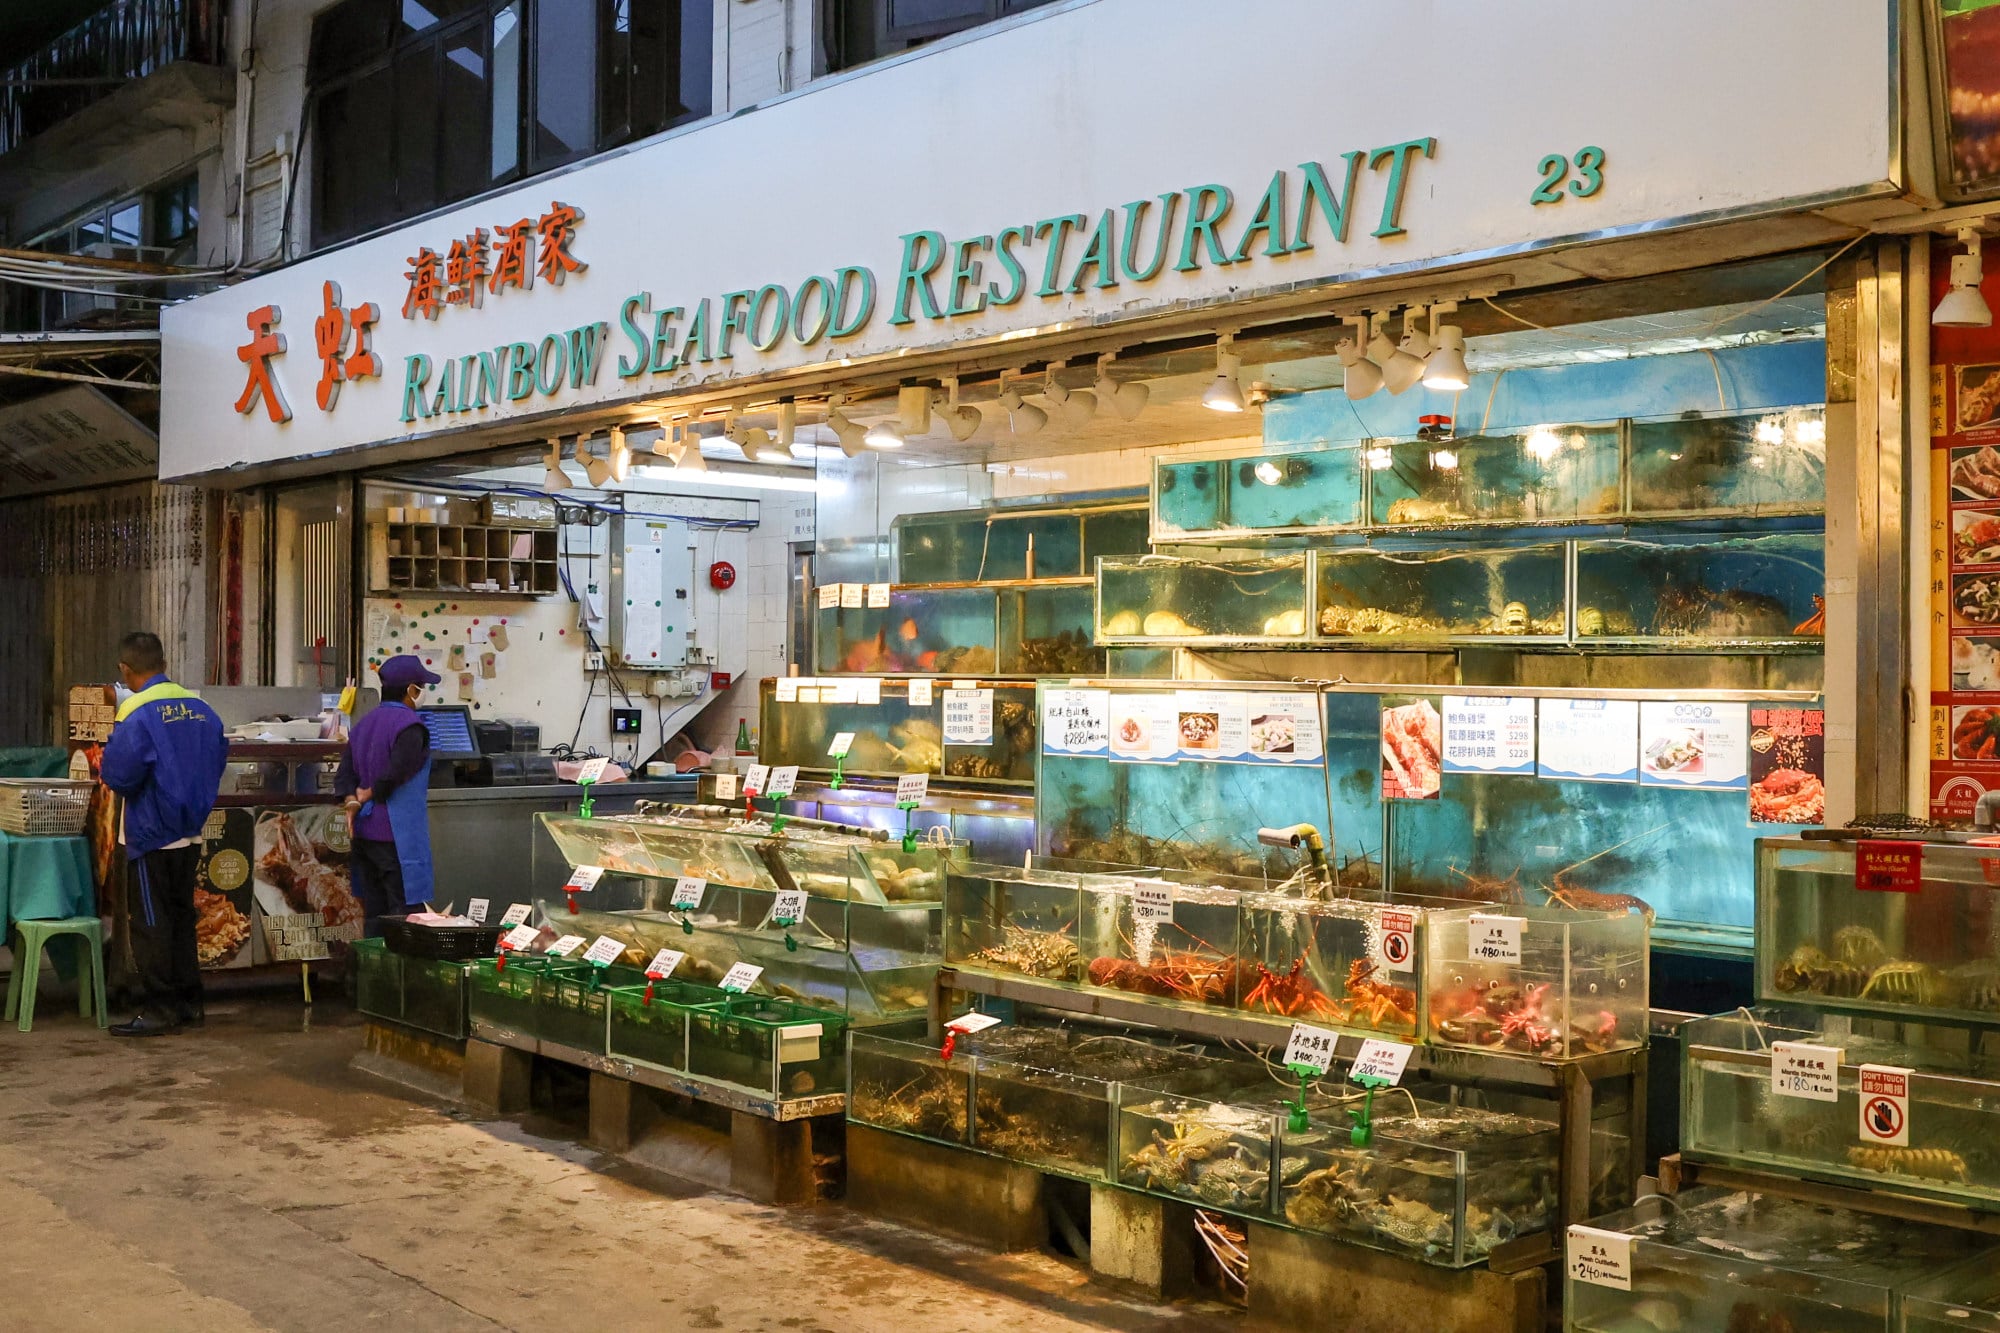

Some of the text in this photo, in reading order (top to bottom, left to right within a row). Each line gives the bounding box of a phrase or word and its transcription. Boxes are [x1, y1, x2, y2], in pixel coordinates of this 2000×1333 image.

[1530, 146, 1605, 205] 23
[402, 201, 589, 321] 海鮮酒家
[399, 137, 1436, 422] RAINBOW SEAFOOD RESTAURANT
[234, 280, 382, 423] 天虹
[1931, 519, 1944, 625] 必食推介
[1509, 715, 1529, 724] $298
[1509, 731, 1529, 740] $298
[1932, 708, 1945, 757] 創意菜
[1509, 749, 1529, 758] $228
[1382, 912, 1412, 922] DON'T TOUCH
[1781, 1068, 1832, 1082] Mantis Shrimp (M)
[1863, 1071, 1905, 1084] DON'T TOUCH
[1863, 1081, 1904, 1095] 請勿觸摸
[1579, 1255, 1620, 1268] Fresh Cuttlefish
